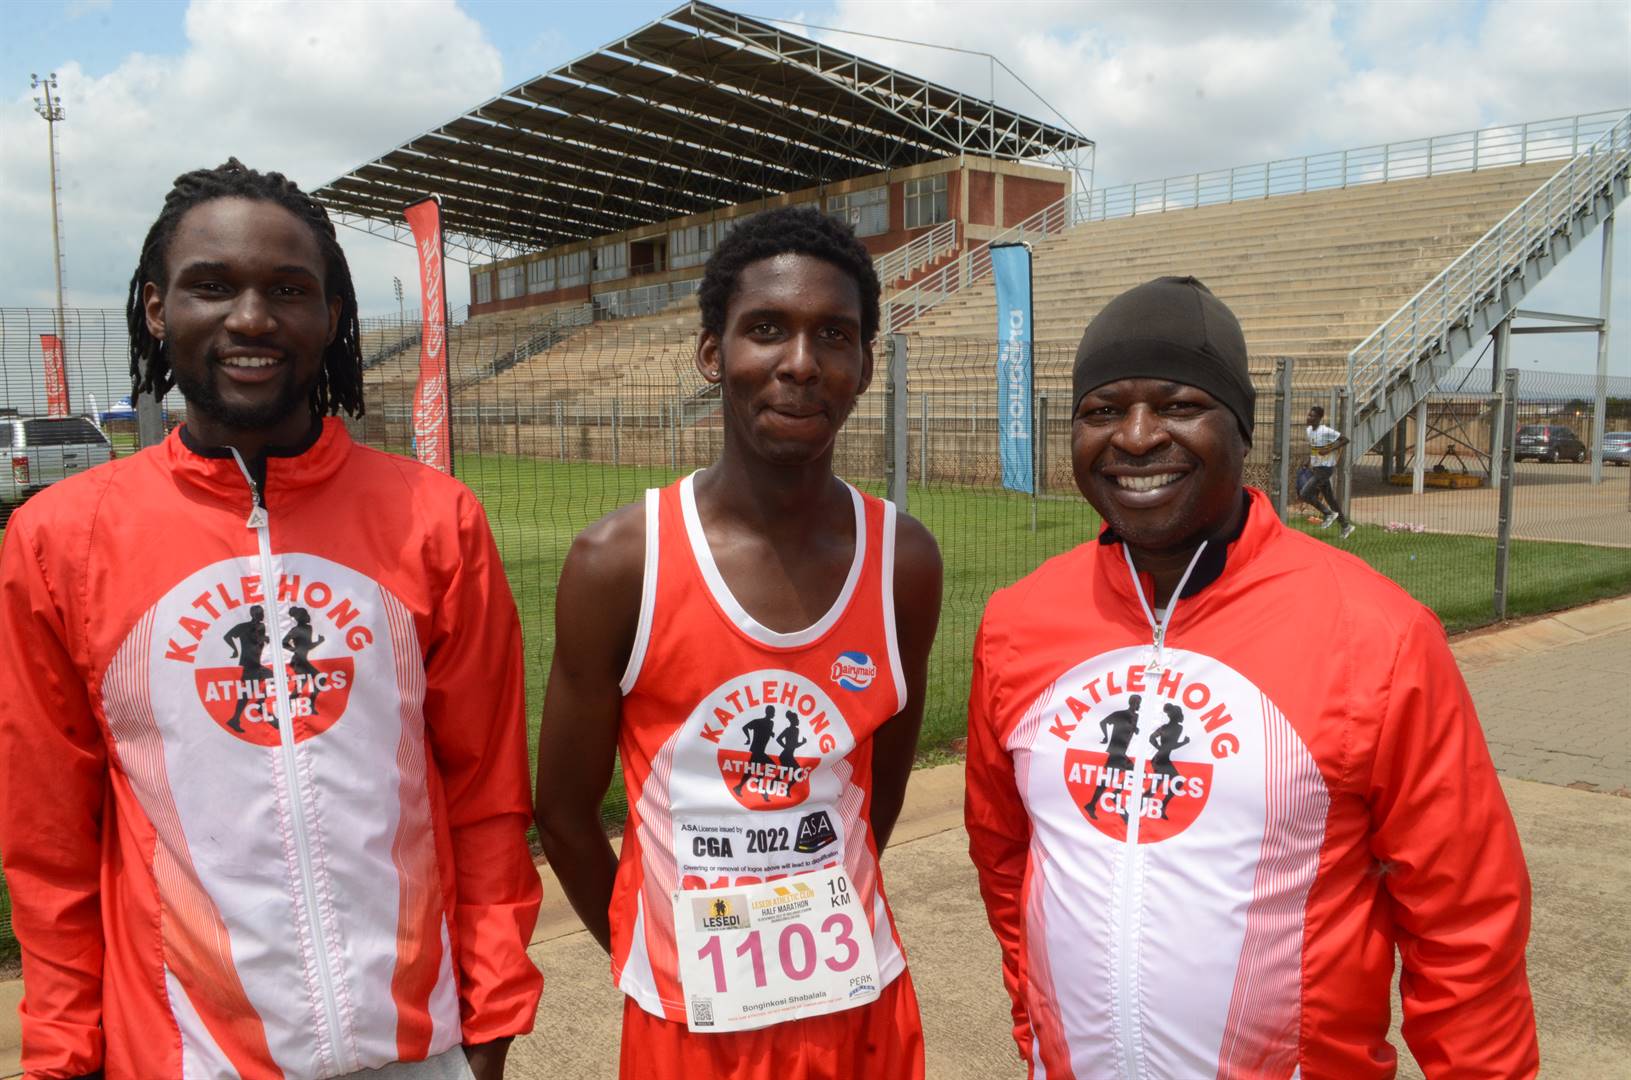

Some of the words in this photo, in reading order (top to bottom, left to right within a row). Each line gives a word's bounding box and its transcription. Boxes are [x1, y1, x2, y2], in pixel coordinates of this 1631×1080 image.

[165, 574, 375, 663] KATLEHONG
[832, 662, 875, 682] Dairymaid
[204, 671, 347, 703] ATHLETICS
[244, 697, 312, 722] CLUB
[699, 681, 836, 754] KATLEHONG
[1049, 664, 1240, 759] KATLEHONG
[722, 758, 812, 783] ATHLETICS
[1068, 762, 1204, 798] ATHLETICS
[747, 778, 789, 797] CLUB
[1100, 793, 1162, 819] CLUB
[736, 826, 743, 834] by
[800, 815, 830, 838] ASA
[692, 836, 733, 858] CGA
[746, 827, 790, 853] 2022
[827, 876, 847, 895] 10
[762, 907, 777, 916] HALF
[777, 900, 809, 913] MARATHON
[831, 892, 851, 908] KM
[703, 915, 740, 928] LESEDI
[697, 912, 860, 994] 1103
[849, 974, 873, 987] PERK
[742, 998, 787, 1012] Bonginkosi
[788, 991, 827, 1003] Shabalala
